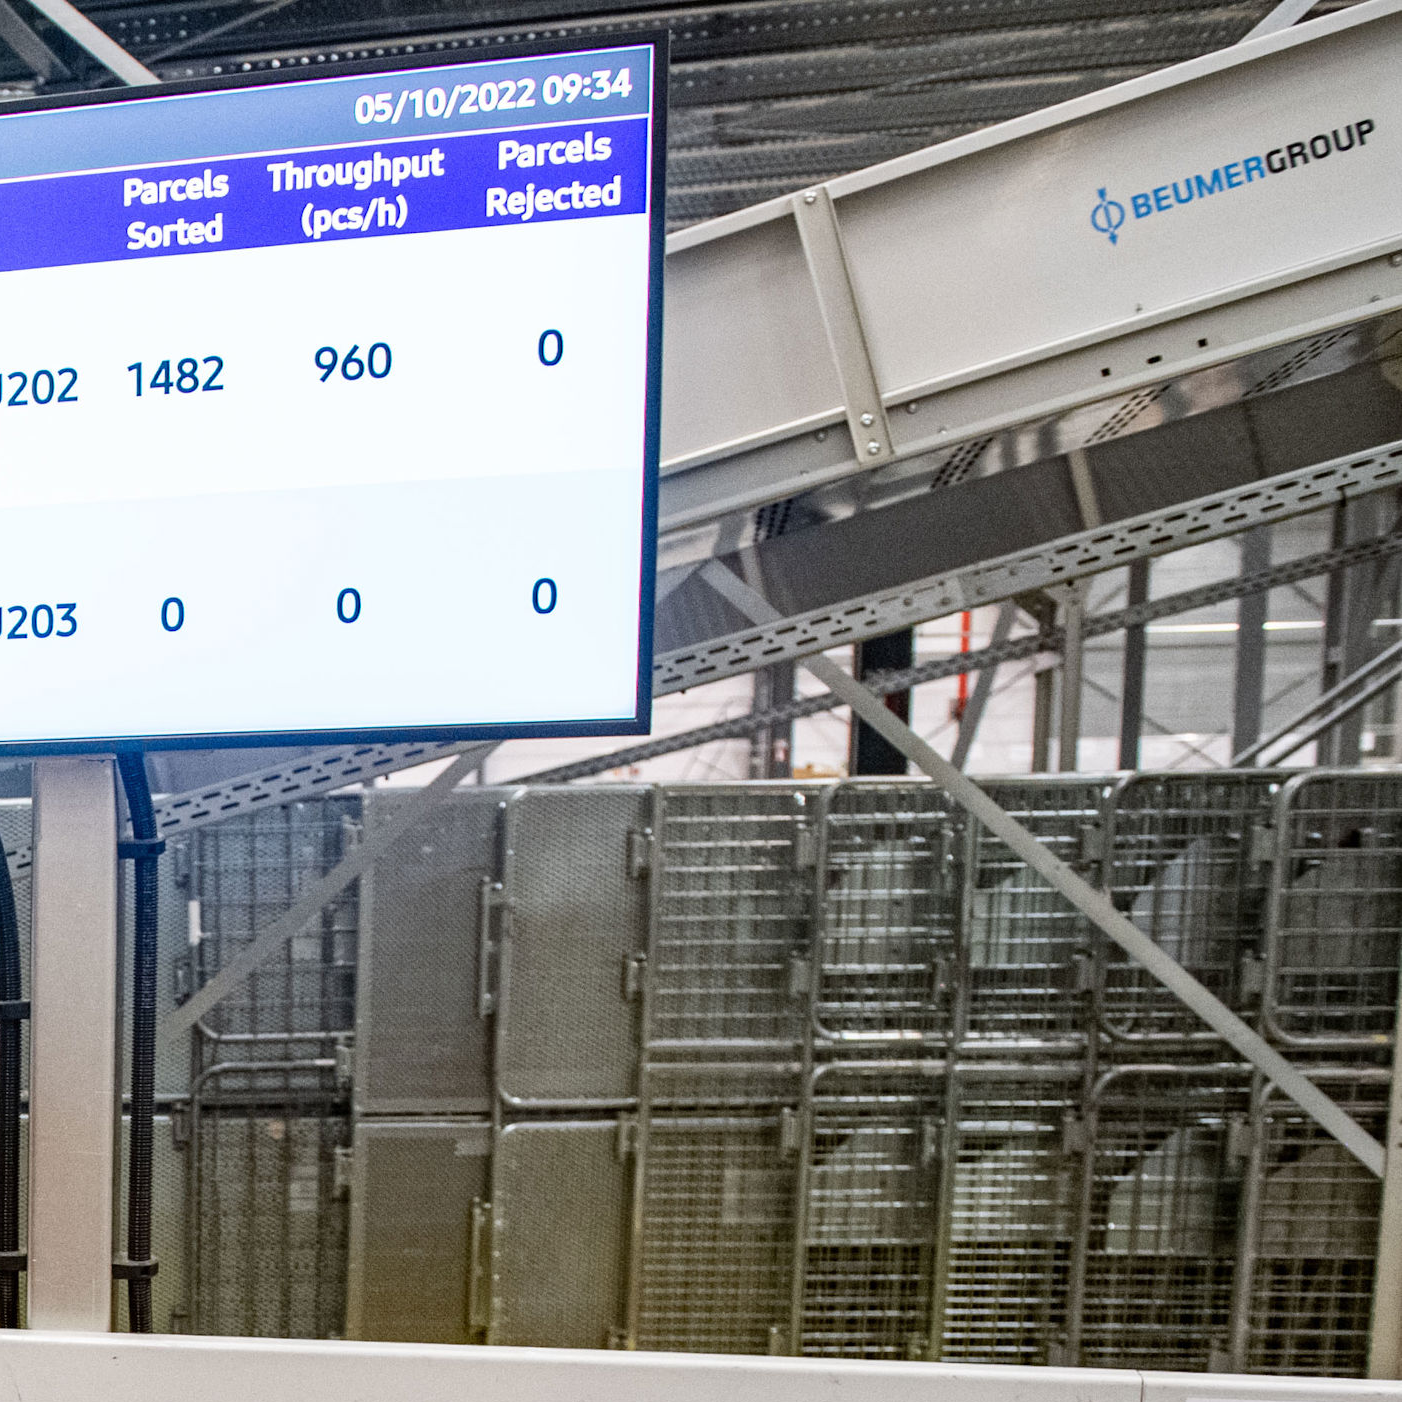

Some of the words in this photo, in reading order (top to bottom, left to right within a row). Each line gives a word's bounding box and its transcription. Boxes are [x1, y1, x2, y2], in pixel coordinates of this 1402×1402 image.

[354, 79, 536, 124] 05/10/2022
[542, 68, 633, 104] 09:34
[498, 132, 611, 169] Parcels
[1131, 118, 1375, 219] BEUMERGROUP
[123, 169, 229, 206] Parcels
[267, 148, 444, 192] Throughput
[301, 196, 408, 237] (pcs/h)
[486, 176, 622, 221] Rejected
[126, 214, 223, 249] Sorted
[313, 343, 393, 382] 960
[538, 329, 564, 367] 0
[126, 356, 225, 397] 1482
[161, 595, 184, 633] 0
[336, 587, 360, 624] 0
[532, 577, 557, 614] 0
